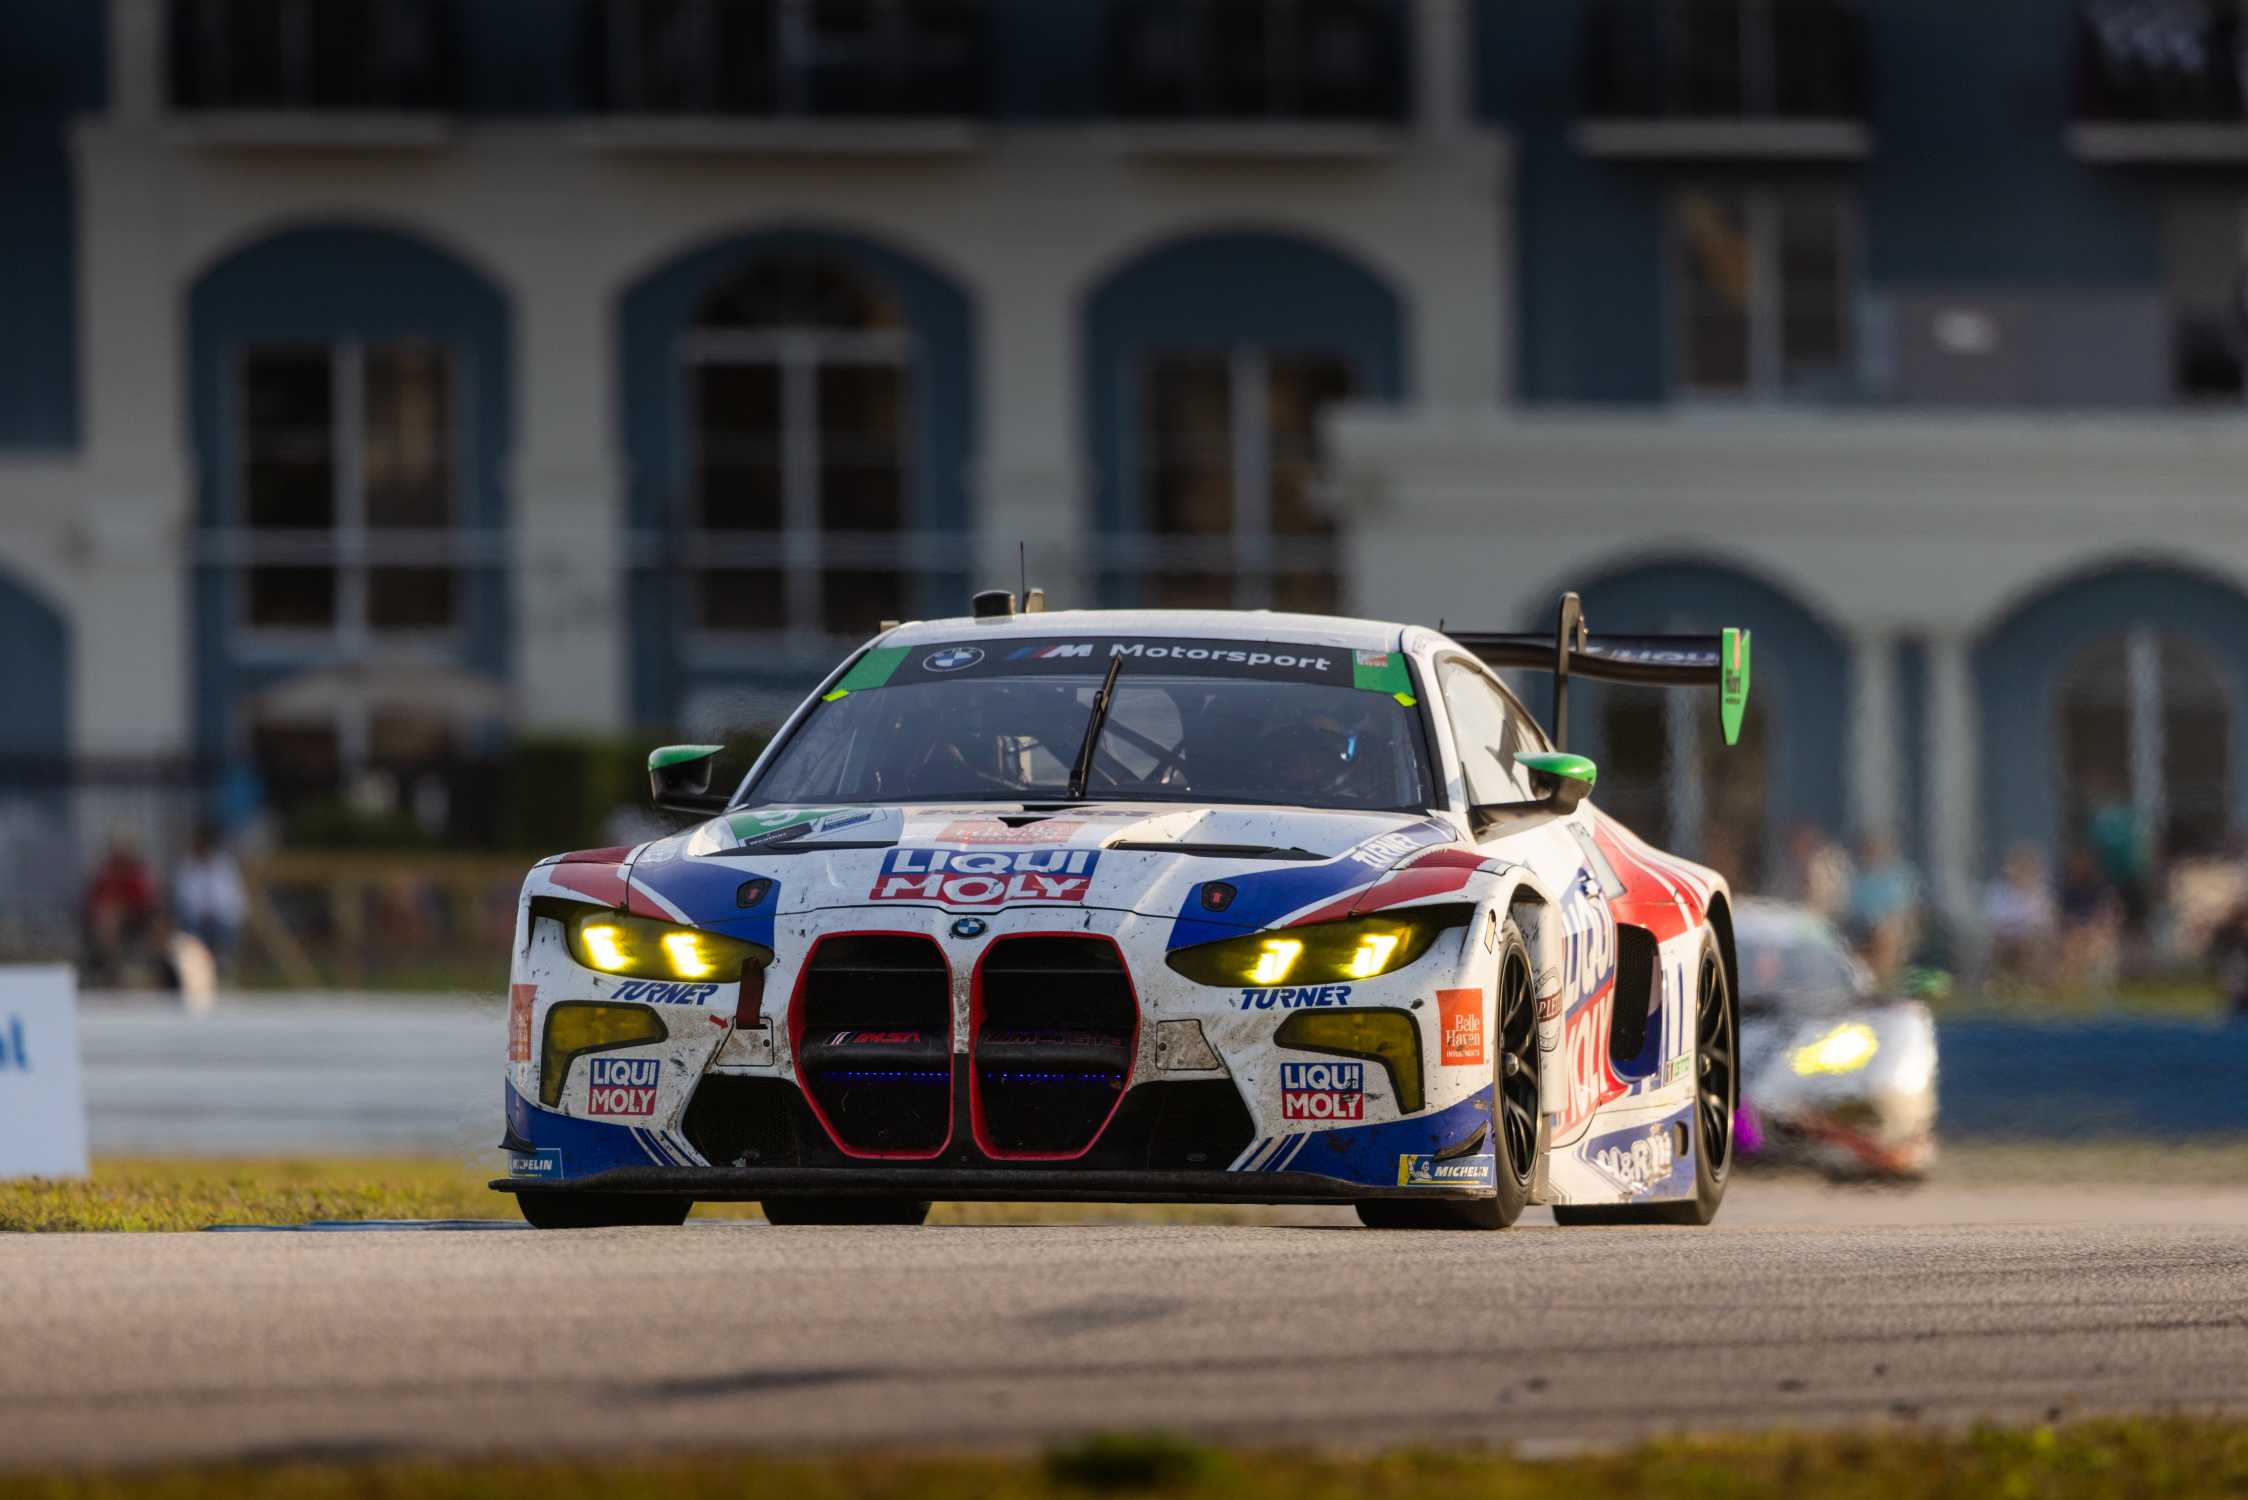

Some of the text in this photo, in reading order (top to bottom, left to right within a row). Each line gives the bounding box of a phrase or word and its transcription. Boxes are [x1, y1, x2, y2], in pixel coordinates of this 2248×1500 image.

[1109, 643, 1331, 672] Motorsport
[890, 850, 1090, 874] LIQUI
[881, 874, 1088, 903] MOLY
[611, 981, 719, 1006] TURNER
[1240, 985, 1352, 1010] TURNER
[1455, 1014, 1480, 1031] Belle
[1445, 1029, 1480, 1047] Haven
[592, 1060, 657, 1087] LIQUI
[1284, 1064, 1360, 1091] LIQUI
[591, 1088, 656, 1113] MOLY
[1285, 1092, 1362, 1118] MOLY
[1434, 1165, 1489, 1177] MICHELIN
